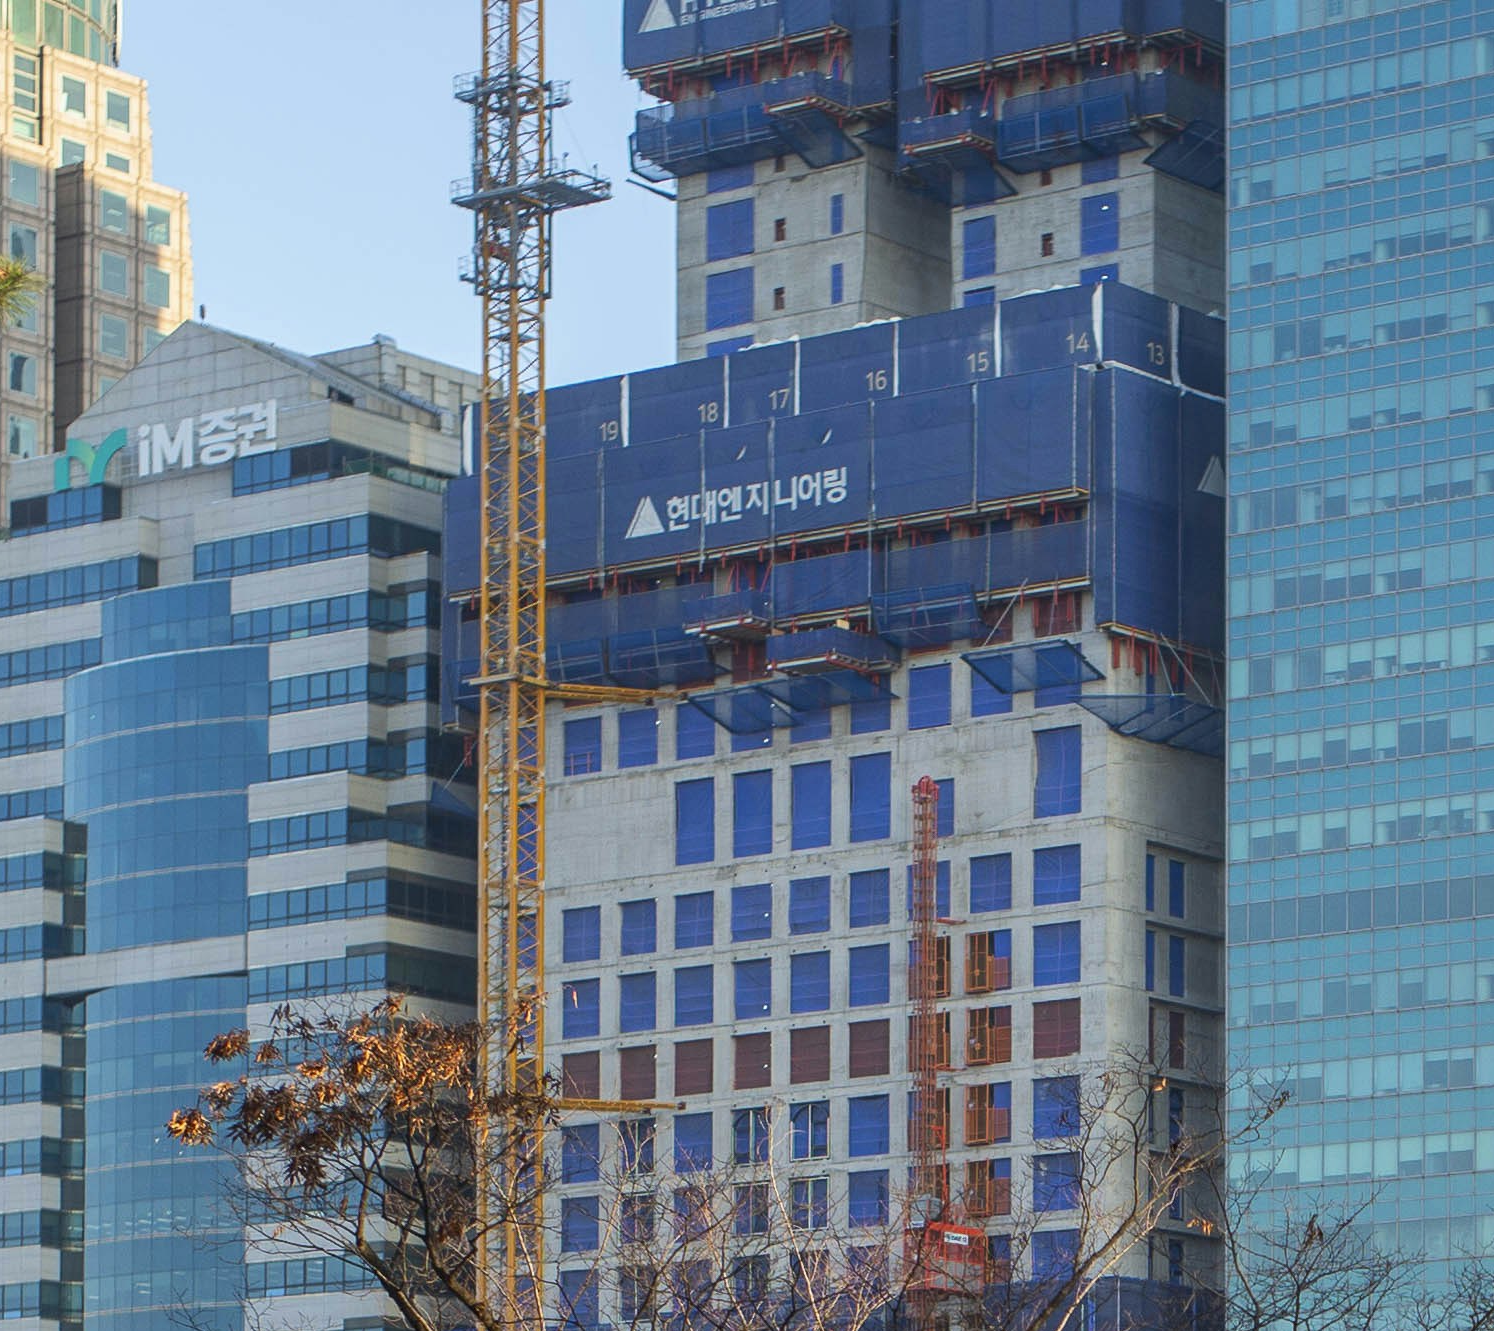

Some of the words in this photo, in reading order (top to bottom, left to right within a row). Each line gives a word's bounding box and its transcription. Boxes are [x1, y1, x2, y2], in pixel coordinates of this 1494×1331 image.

[1066, 332, 1090, 354] 14
[1146, 342, 1164, 365] 13
[966, 351, 989, 374] 15
[866, 370, 887, 391] 16
[769, 388, 790, 410] 17
[698, 402, 718, 423] 18
[137, 399, 277, 477] iM증권
[600, 421, 618, 441] 19
[666, 467, 848, 533] 현대엔지니어링
